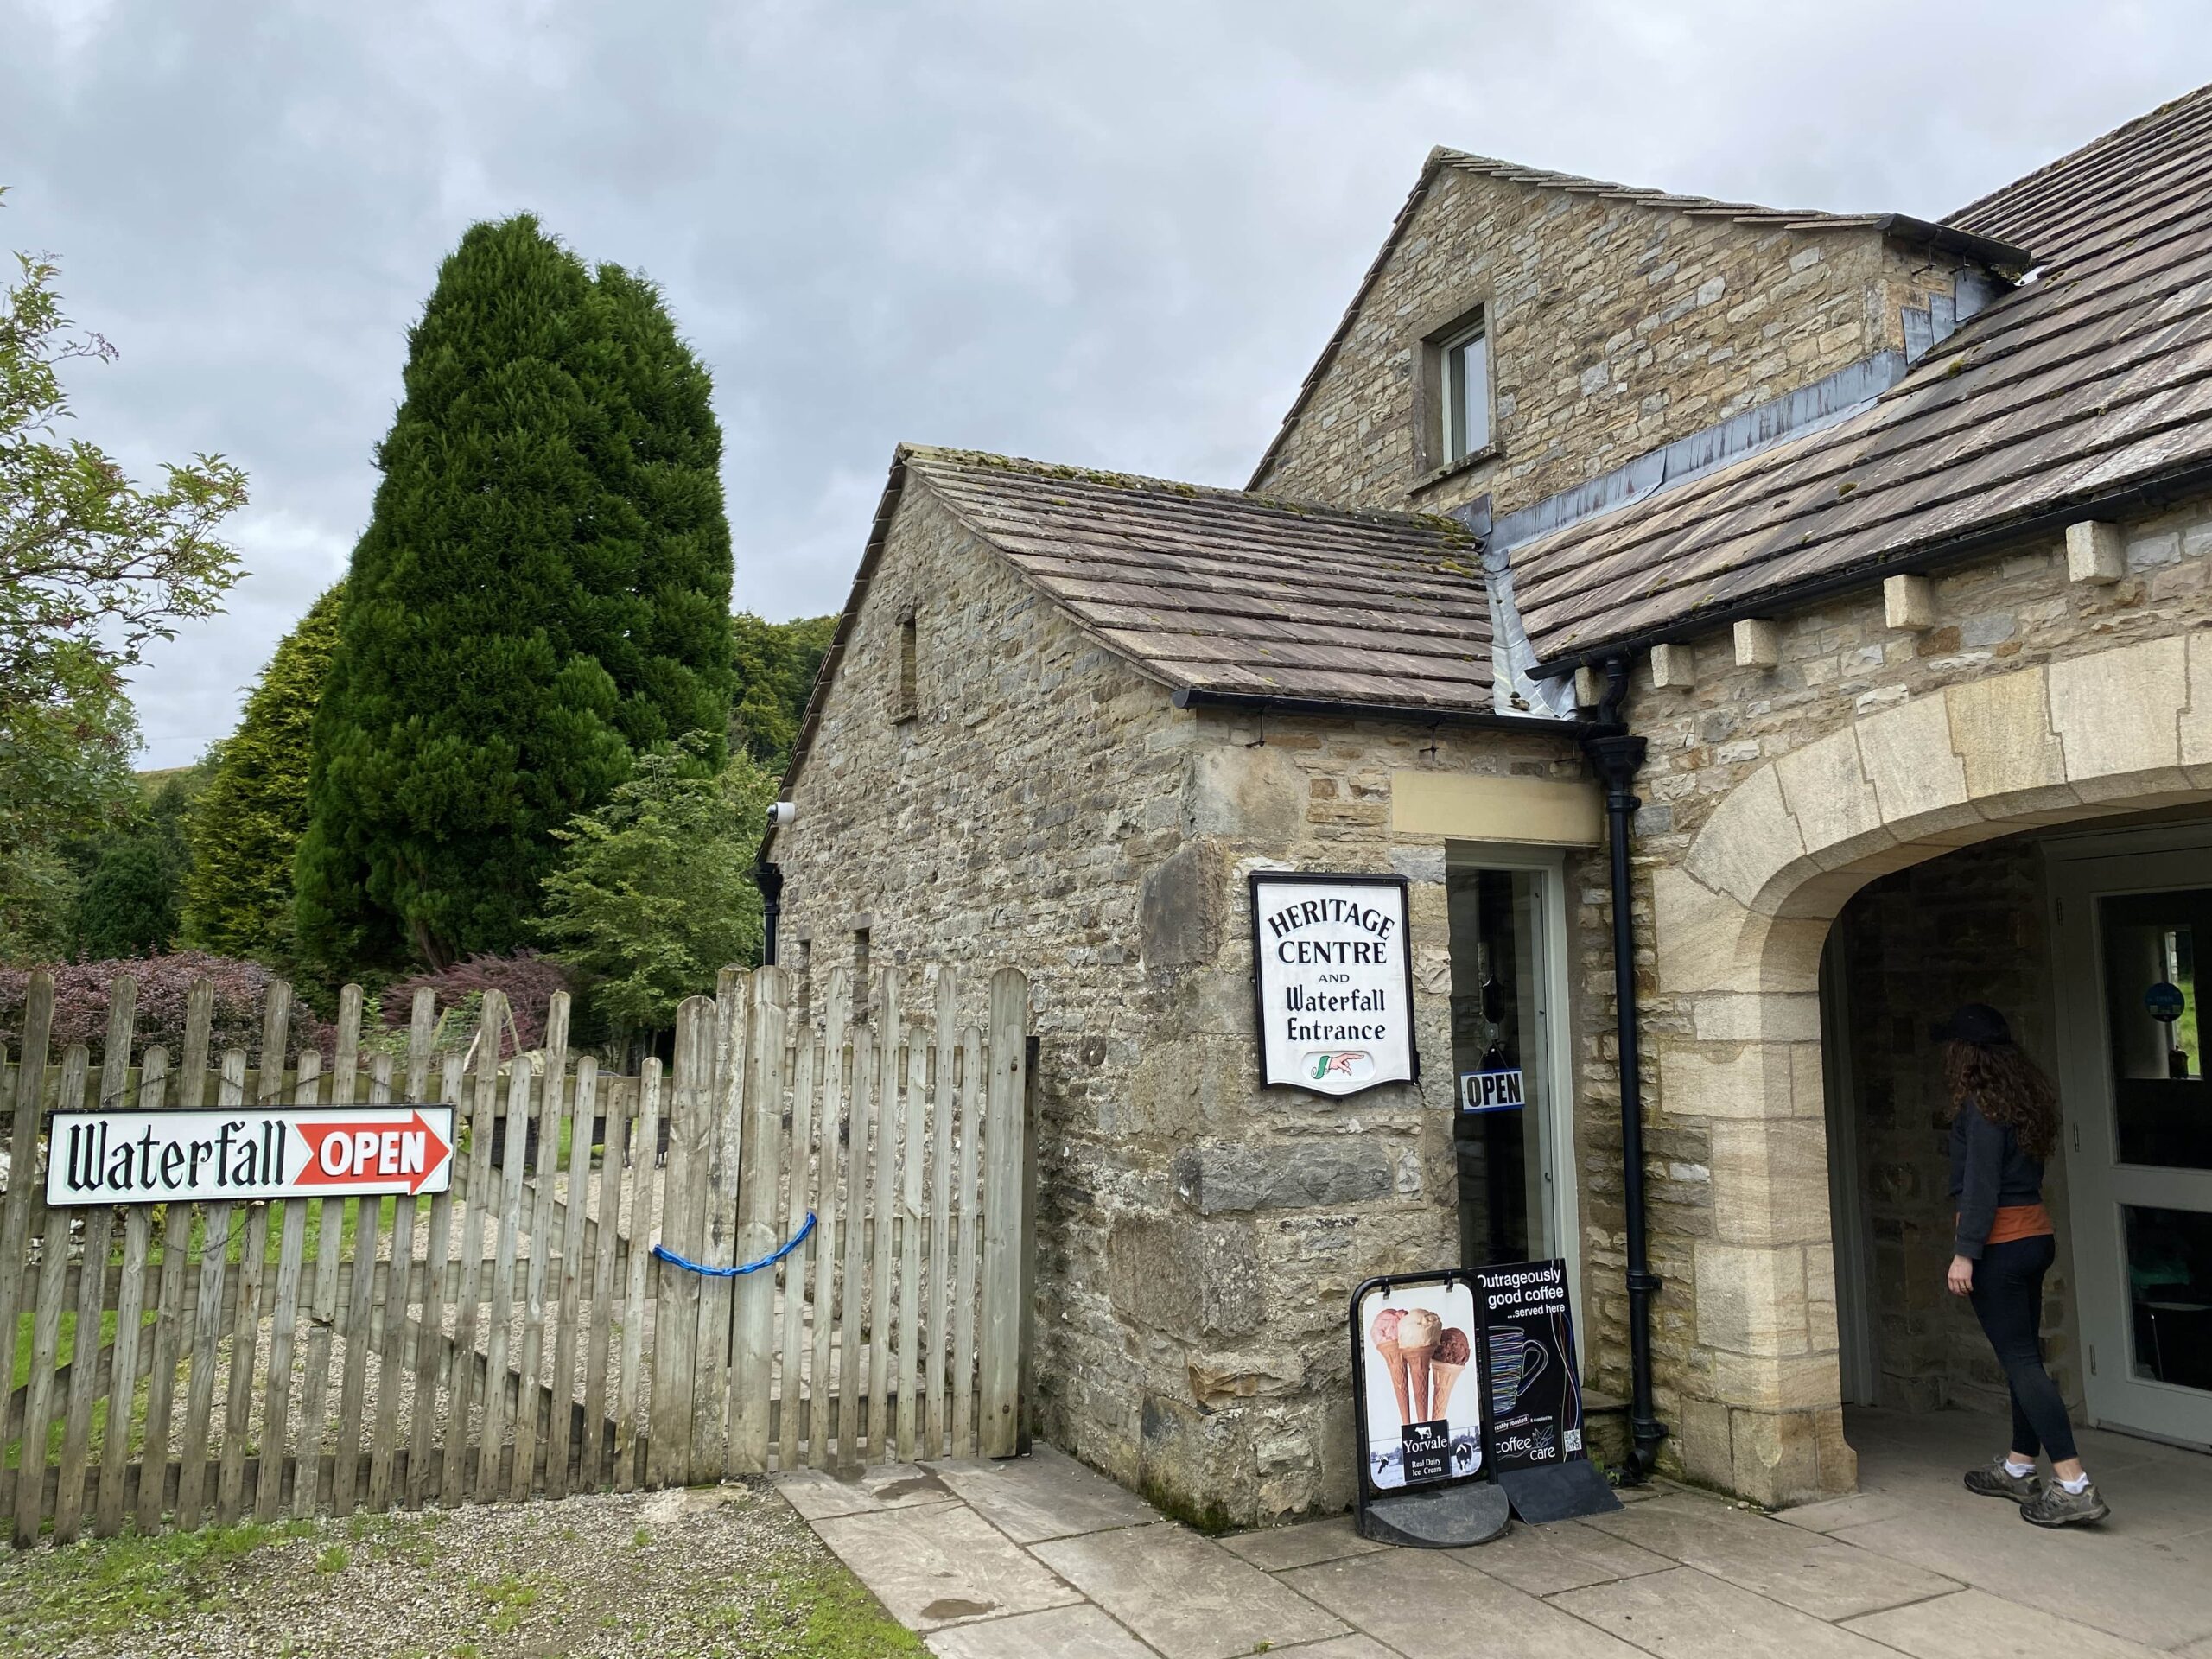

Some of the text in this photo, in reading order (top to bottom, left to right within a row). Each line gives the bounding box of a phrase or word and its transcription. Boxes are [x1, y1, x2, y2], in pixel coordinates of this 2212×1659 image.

[1267, 899, 1395, 940] HERITAGE
[1277, 941, 1388, 964] CENTRE
[1318, 974, 1350, 983] AND
[1286, 983, 1386, 1013] Waterfall
[1287, 1018, 1386, 1041] Entrance
[1467, 1071, 1522, 1107] OPEN
[65, 1120, 426, 1192] Waterfall OPEN
[1488, 1285, 1564, 1310] good coffee
[1507, 1303, 1566, 1319] ...served here
[1494, 1415, 1528, 1431] reshly roasted
[1402, 1434, 1448, 1454] Yorvale
[1495, 1436, 1533, 1454] coffee
[1529, 1446, 1556, 1461] care
[1411, 1458, 1441, 1469] Real Dairy
[1423, 1466, 1442, 1475] Cream
